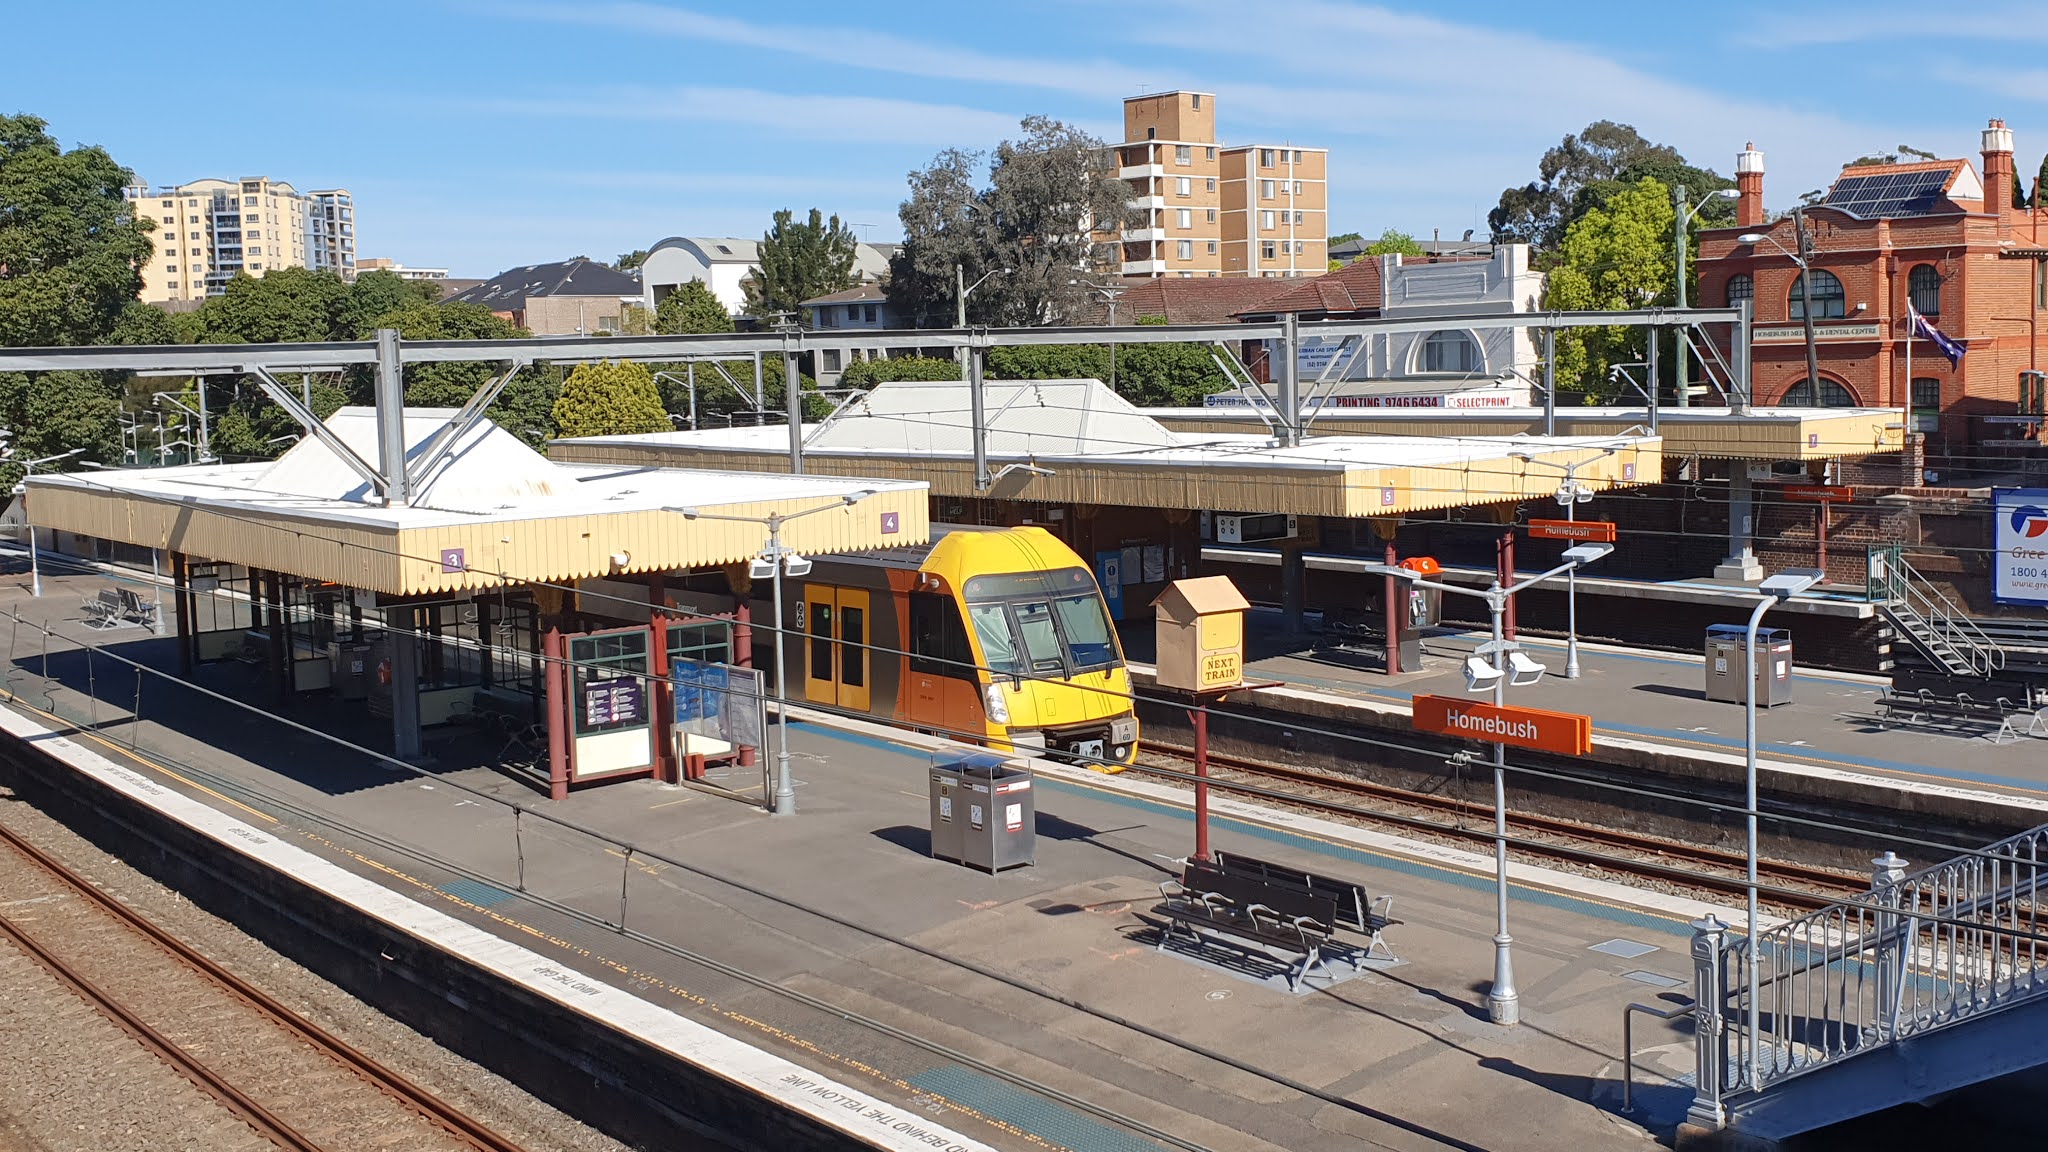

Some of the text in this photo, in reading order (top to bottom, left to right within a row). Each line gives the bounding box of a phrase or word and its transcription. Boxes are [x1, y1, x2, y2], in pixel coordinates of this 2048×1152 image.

[1790, 329, 1818, 337] MEDAL
[1216, 397, 1236, 406] PETER
[1336, 396, 1438, 407] PRINTING 9746 6434
[1456, 396, 1511, 407] SELECTPRINT
[1626, 466, 1632, 476] 6
[1385, 491, 1391, 502] 5
[886, 516, 895, 529] 4
[1545, 524, 1590, 537] Homebush
[448, 553, 458, 567] 3
[2010, 566, 2038, 578] 1800
[1207, 658, 1234, 670] NEXT
[1205, 668, 1236, 680] TRAIN
[1446, 707, 1538, 740] Homebush
[1425, 849, 1452, 858] THE
[1451, 855, 1482, 864] GAP
[552, 974, 577, 986] THE
[779, 1073, 814, 1092] LINE
[814, 1084, 867, 1114] YELLOW
[862, 1108, 897, 1126] THE
[892, 1121, 951, 1148] BEHIND
